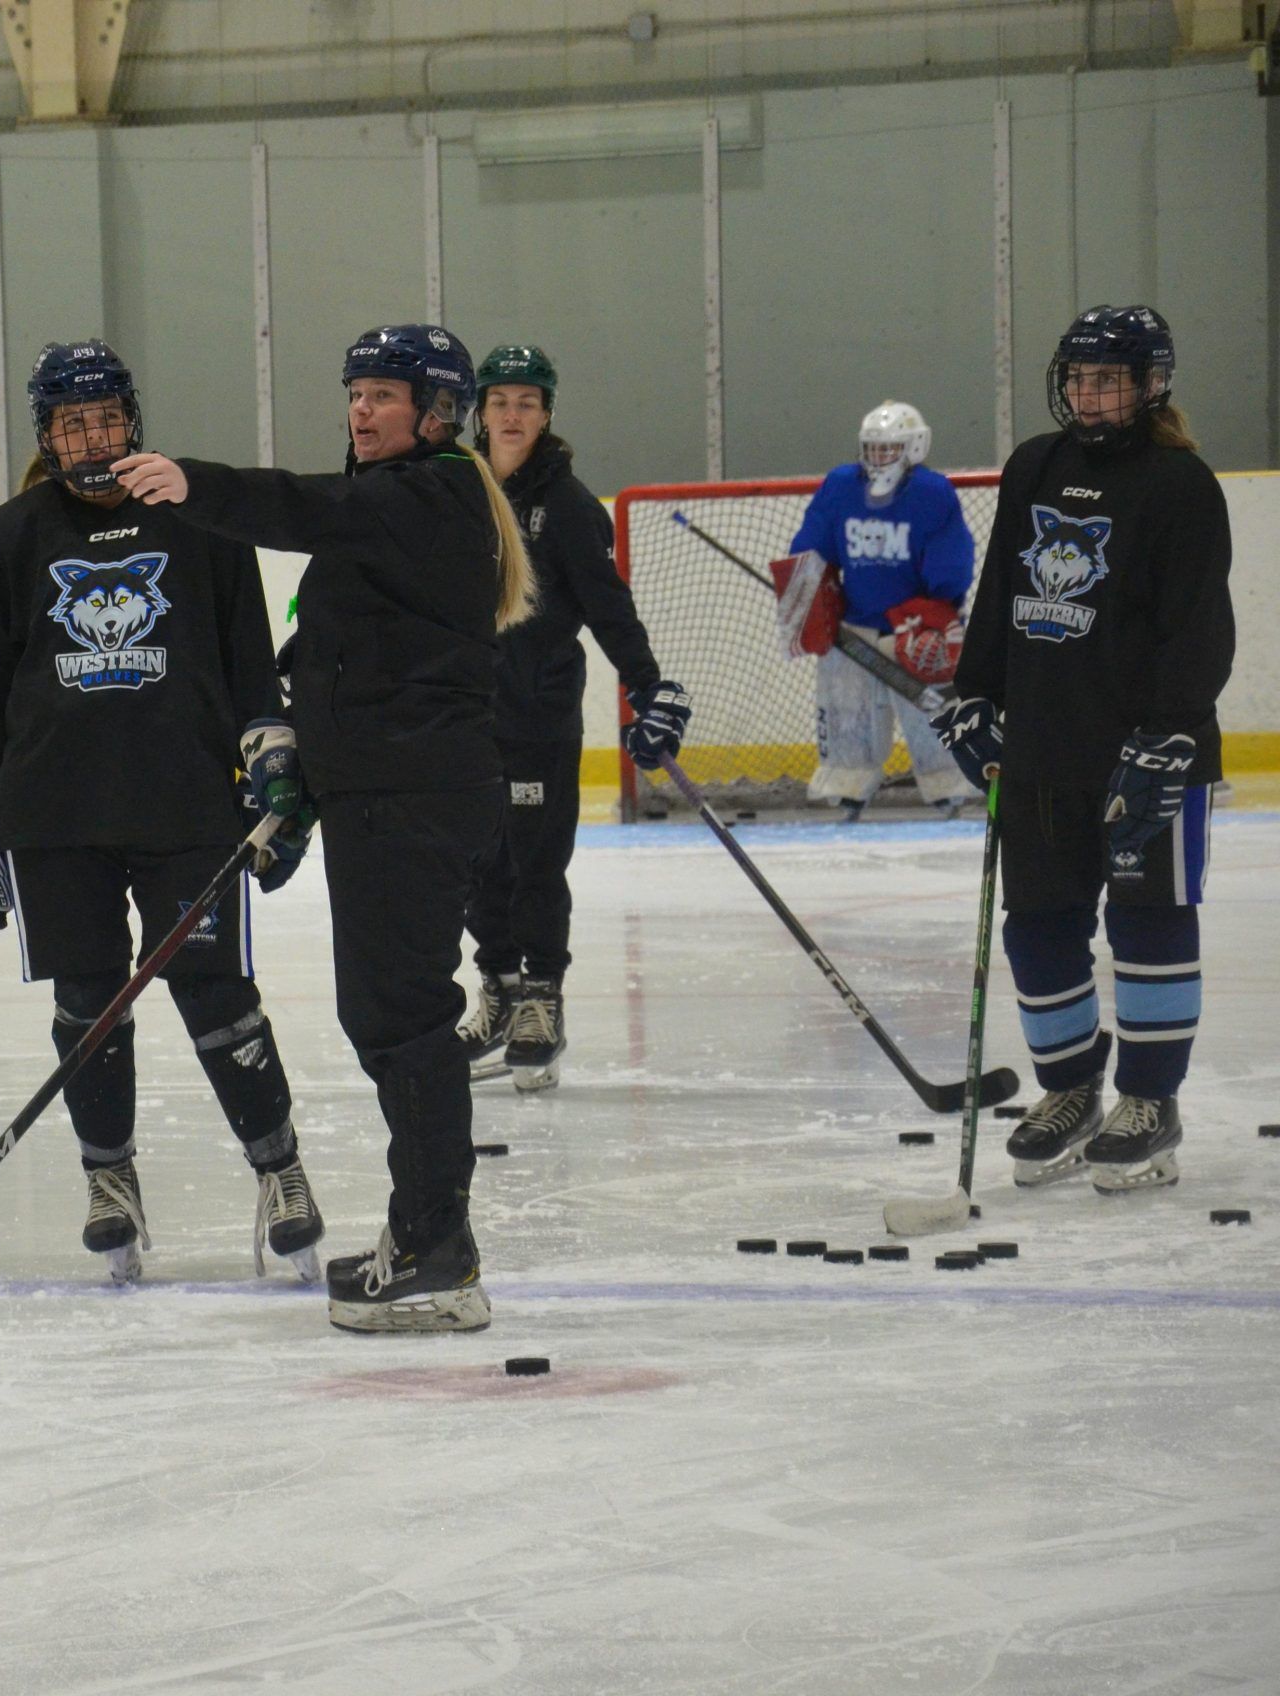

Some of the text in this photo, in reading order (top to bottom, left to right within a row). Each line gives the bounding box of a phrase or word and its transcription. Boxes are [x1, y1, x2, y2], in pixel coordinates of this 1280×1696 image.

[351, 347, 380, 357] CCM
[74, 372, 105, 383] CCM
[426, 367, 461, 382] NIPISSING
[84, 472, 117, 484] CCM
[1062, 487, 1102, 500] CCM
[89, 526, 139, 542] CCM
[1017, 599, 1092, 631] WESTERN
[60, 650, 163, 679] WESTERN
[82, 670, 141, 686] WOLVES
[1120, 746, 1194, 772] CCM
[809, 949, 871, 1022] CCM
